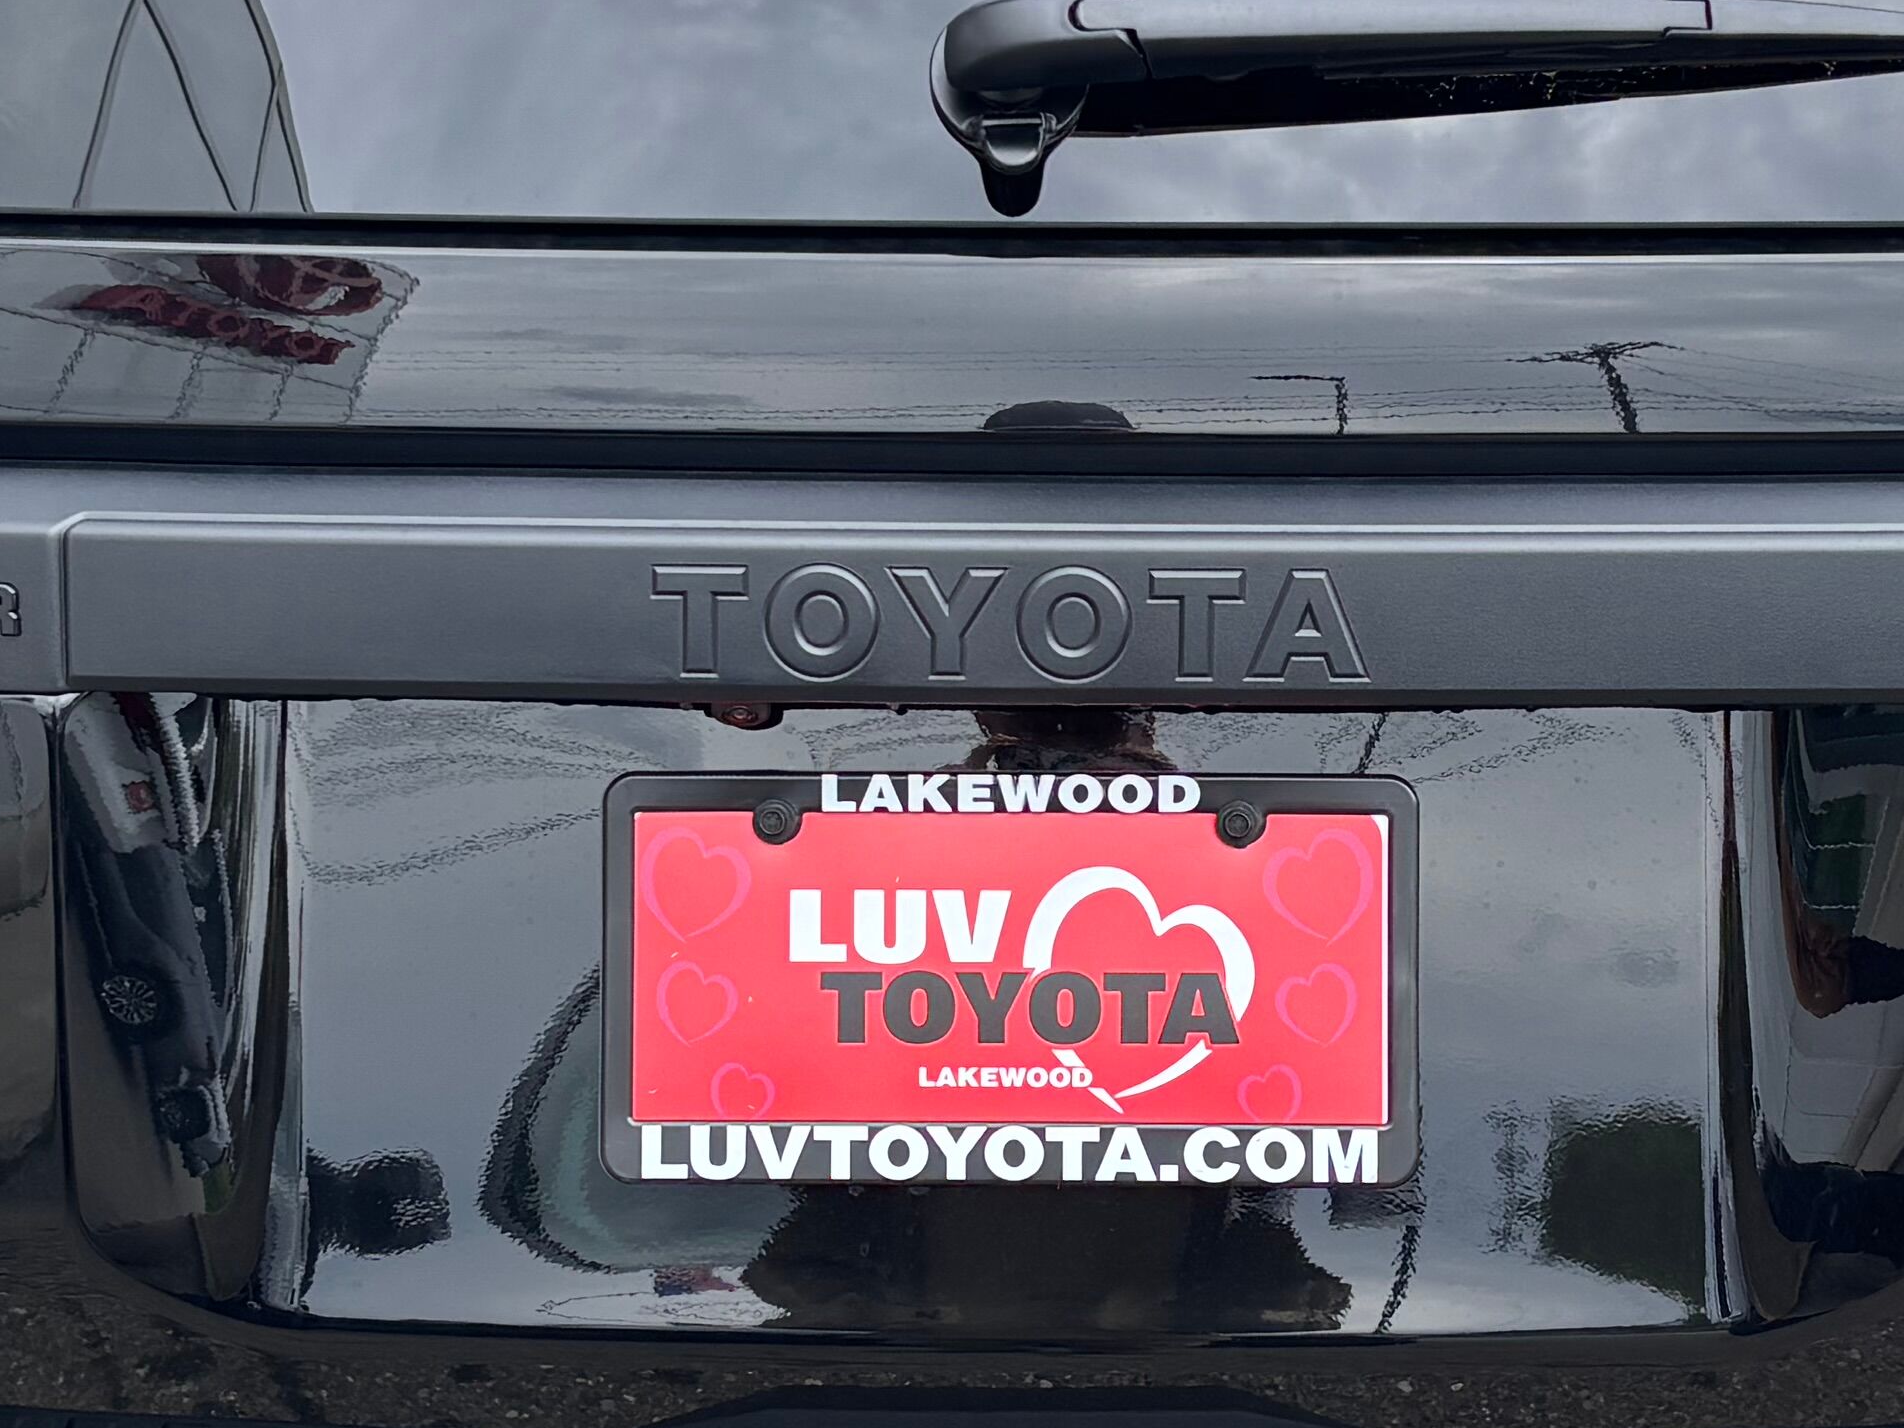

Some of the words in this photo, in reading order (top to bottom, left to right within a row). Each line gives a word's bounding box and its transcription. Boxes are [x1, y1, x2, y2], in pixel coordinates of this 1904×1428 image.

[650, 562, 1373, 684] TOYOTA
[820, 772, 1202, 815] LAKEWOOD
[788, 888, 1013, 965] LUV
[820, 970, 1240, 1046] TOYOTA
[918, 1065, 1094, 1090] LAKEWOOD
[639, 1123, 1379, 1185] LUVTOYOTA.COM
